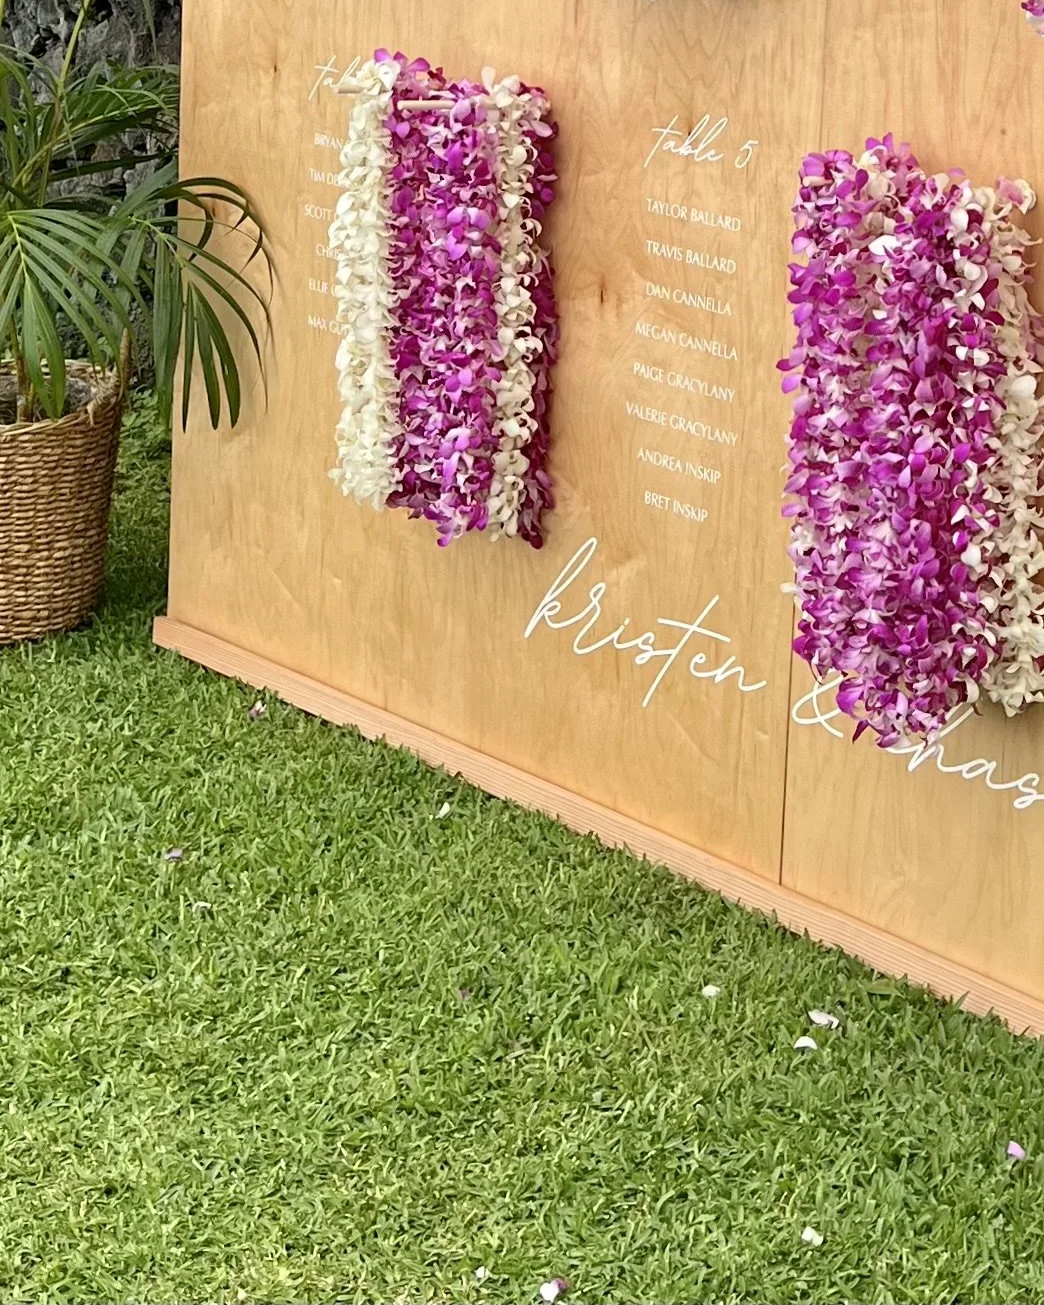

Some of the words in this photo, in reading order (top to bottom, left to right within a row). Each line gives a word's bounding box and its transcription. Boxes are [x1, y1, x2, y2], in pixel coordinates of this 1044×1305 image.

[643, 113, 728, 168] table
[734, 139, 759, 168] 5
[646, 198, 687, 220] TAYLOR
[690, 207, 741, 232] BALLARD
[646, 240, 682, 261] TRAVIS
[685, 249, 736, 274] BALLARD
[645, 281, 671, 300] DAN
[673, 288, 732, 315] CANNELLA
[635, 321, 677, 344] MEGAN
[678, 333, 738, 360] CANNELLA
[633, 362, 664, 383] PAIGE
[667, 371, 735, 403] GRACYLANY
[625, 400, 667, 426] VALERIE
[669, 415, 738, 446] GRACYLANY
[637, 447, 682, 472] ANDREA
[685, 462, 721, 484] INSKIP
[644, 490, 670, 511] BRET
[673, 501, 709, 523] INSKIP
[524, 536, 767, 707] kristen
